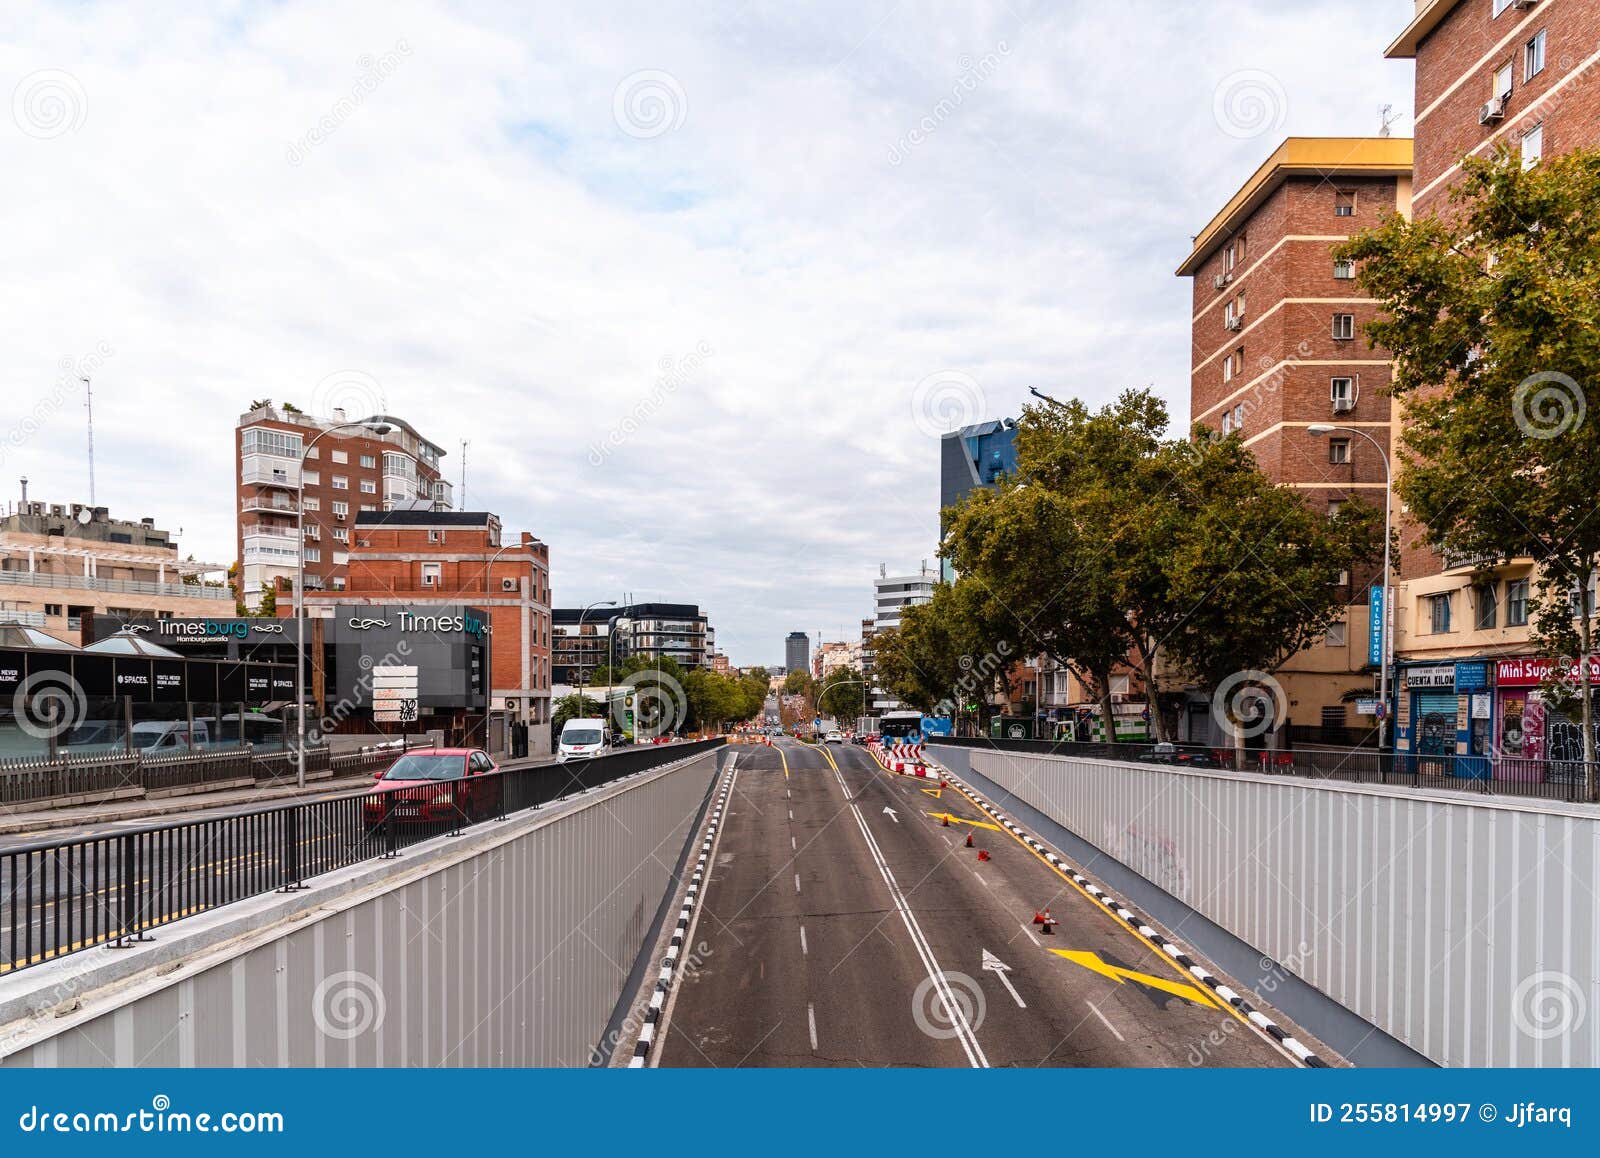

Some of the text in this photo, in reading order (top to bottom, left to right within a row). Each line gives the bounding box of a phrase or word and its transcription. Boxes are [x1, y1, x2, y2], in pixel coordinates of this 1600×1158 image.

[157, 619, 247, 638] Timesburg
[1500, 663, 1523, 678] Mini
[124, 675, 148, 684] SPACES.
[1408, 675, 1431, 686] CUENTA
